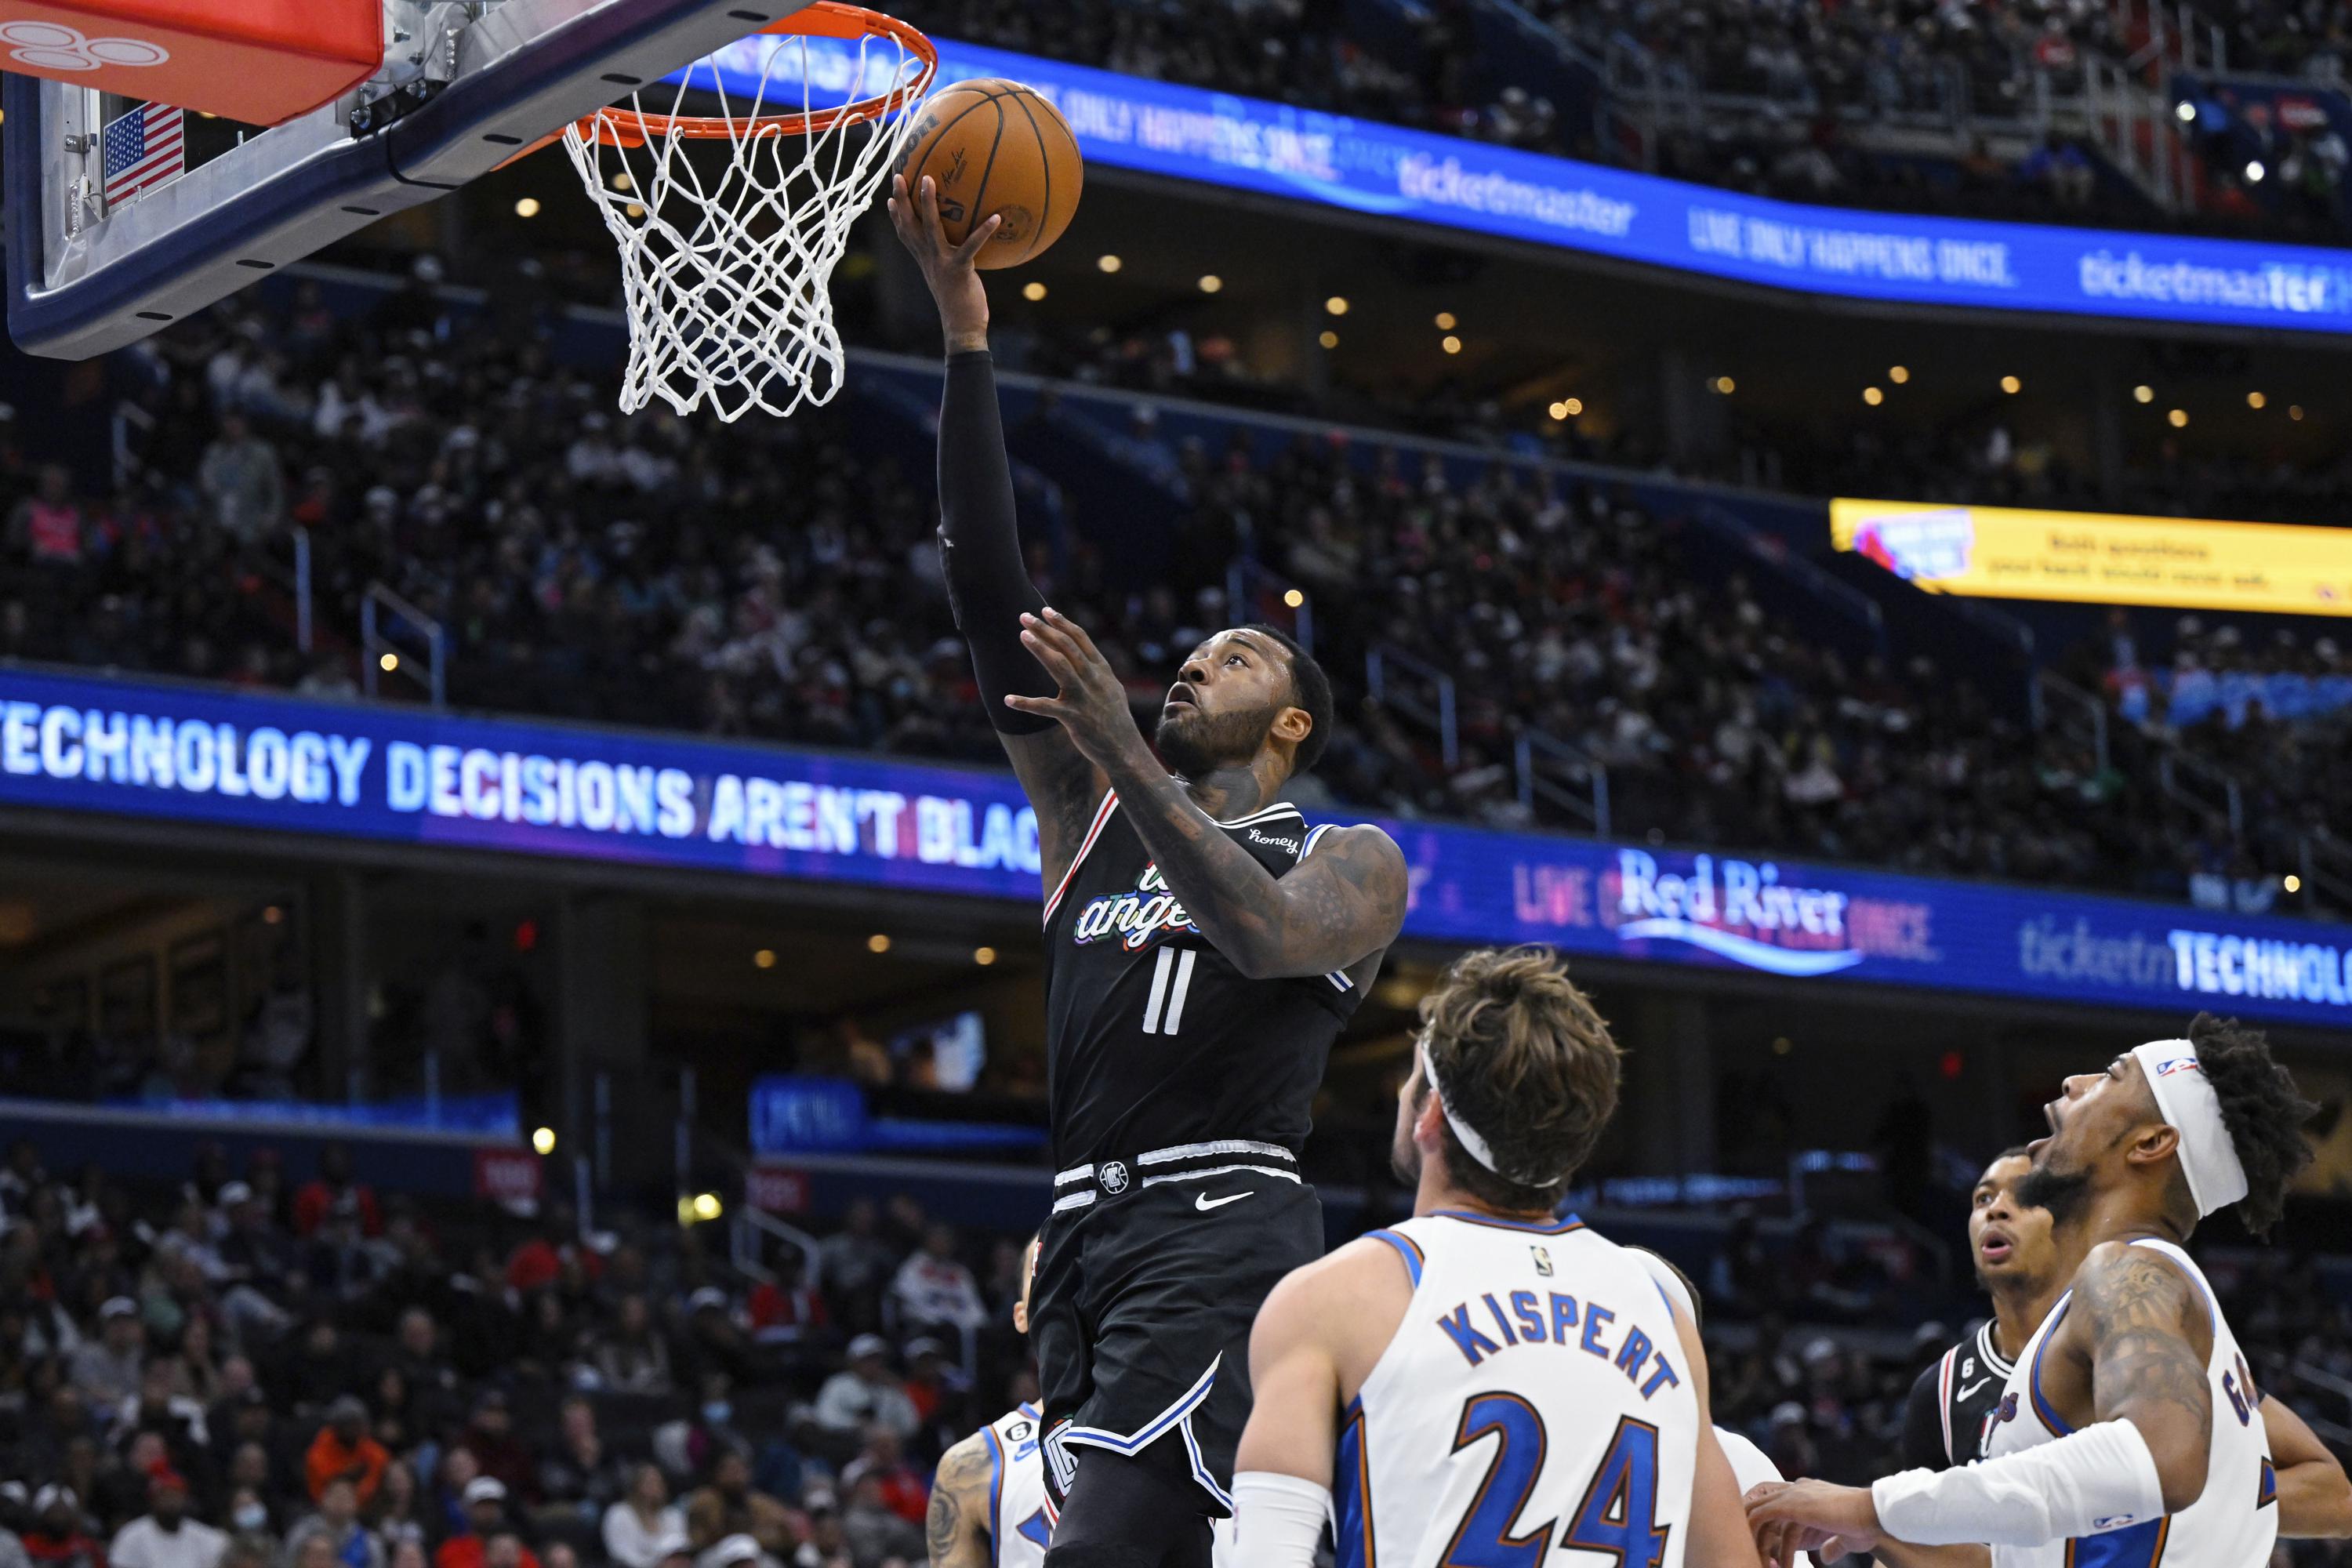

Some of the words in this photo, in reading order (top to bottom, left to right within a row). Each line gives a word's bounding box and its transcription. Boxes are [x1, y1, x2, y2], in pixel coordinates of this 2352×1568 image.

[1399, 151, 1637, 238] ticketmaster
[0, 699, 372, 808] ECHNOLOGY
[387, 740, 697, 839] DECISIONS
[707, 774, 907, 860] AREN'T
[1249, 828, 1298, 855] honey
[1617, 848, 1715, 922] Red
[1722, 859, 1849, 936] River
[1142, 946, 1197, 1036] 11
[1436, 1290, 1679, 1402] KISPERT
[1962, 1357, 1975, 1379] 6
[1010, 1422, 1028, 1440] 6
[1437, 1390, 1671, 1568] 24
